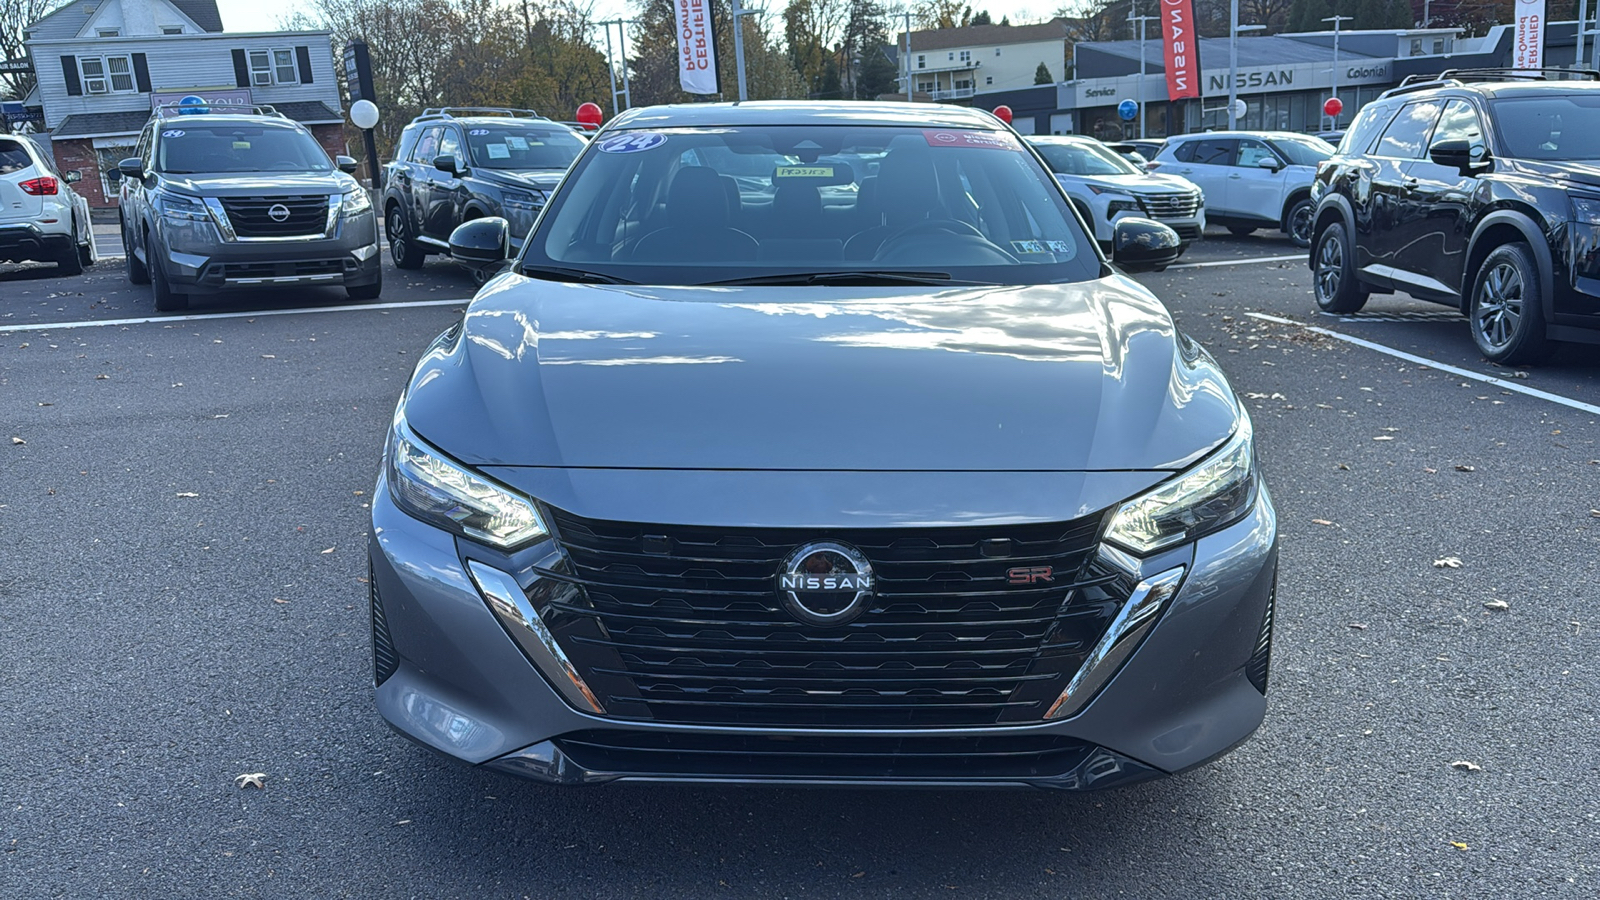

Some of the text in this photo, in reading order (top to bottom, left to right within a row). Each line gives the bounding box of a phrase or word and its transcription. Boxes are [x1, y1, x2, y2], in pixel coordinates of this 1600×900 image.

[1209, 69, 1294, 91] NISSAN
[1347, 65, 1387, 79] Colonial
[1085, 87, 1116, 98] Service
[606, 132, 657, 152] 24
[781, 576, 871, 590] NISSAN
[1006, 566, 1053, 585] SR
